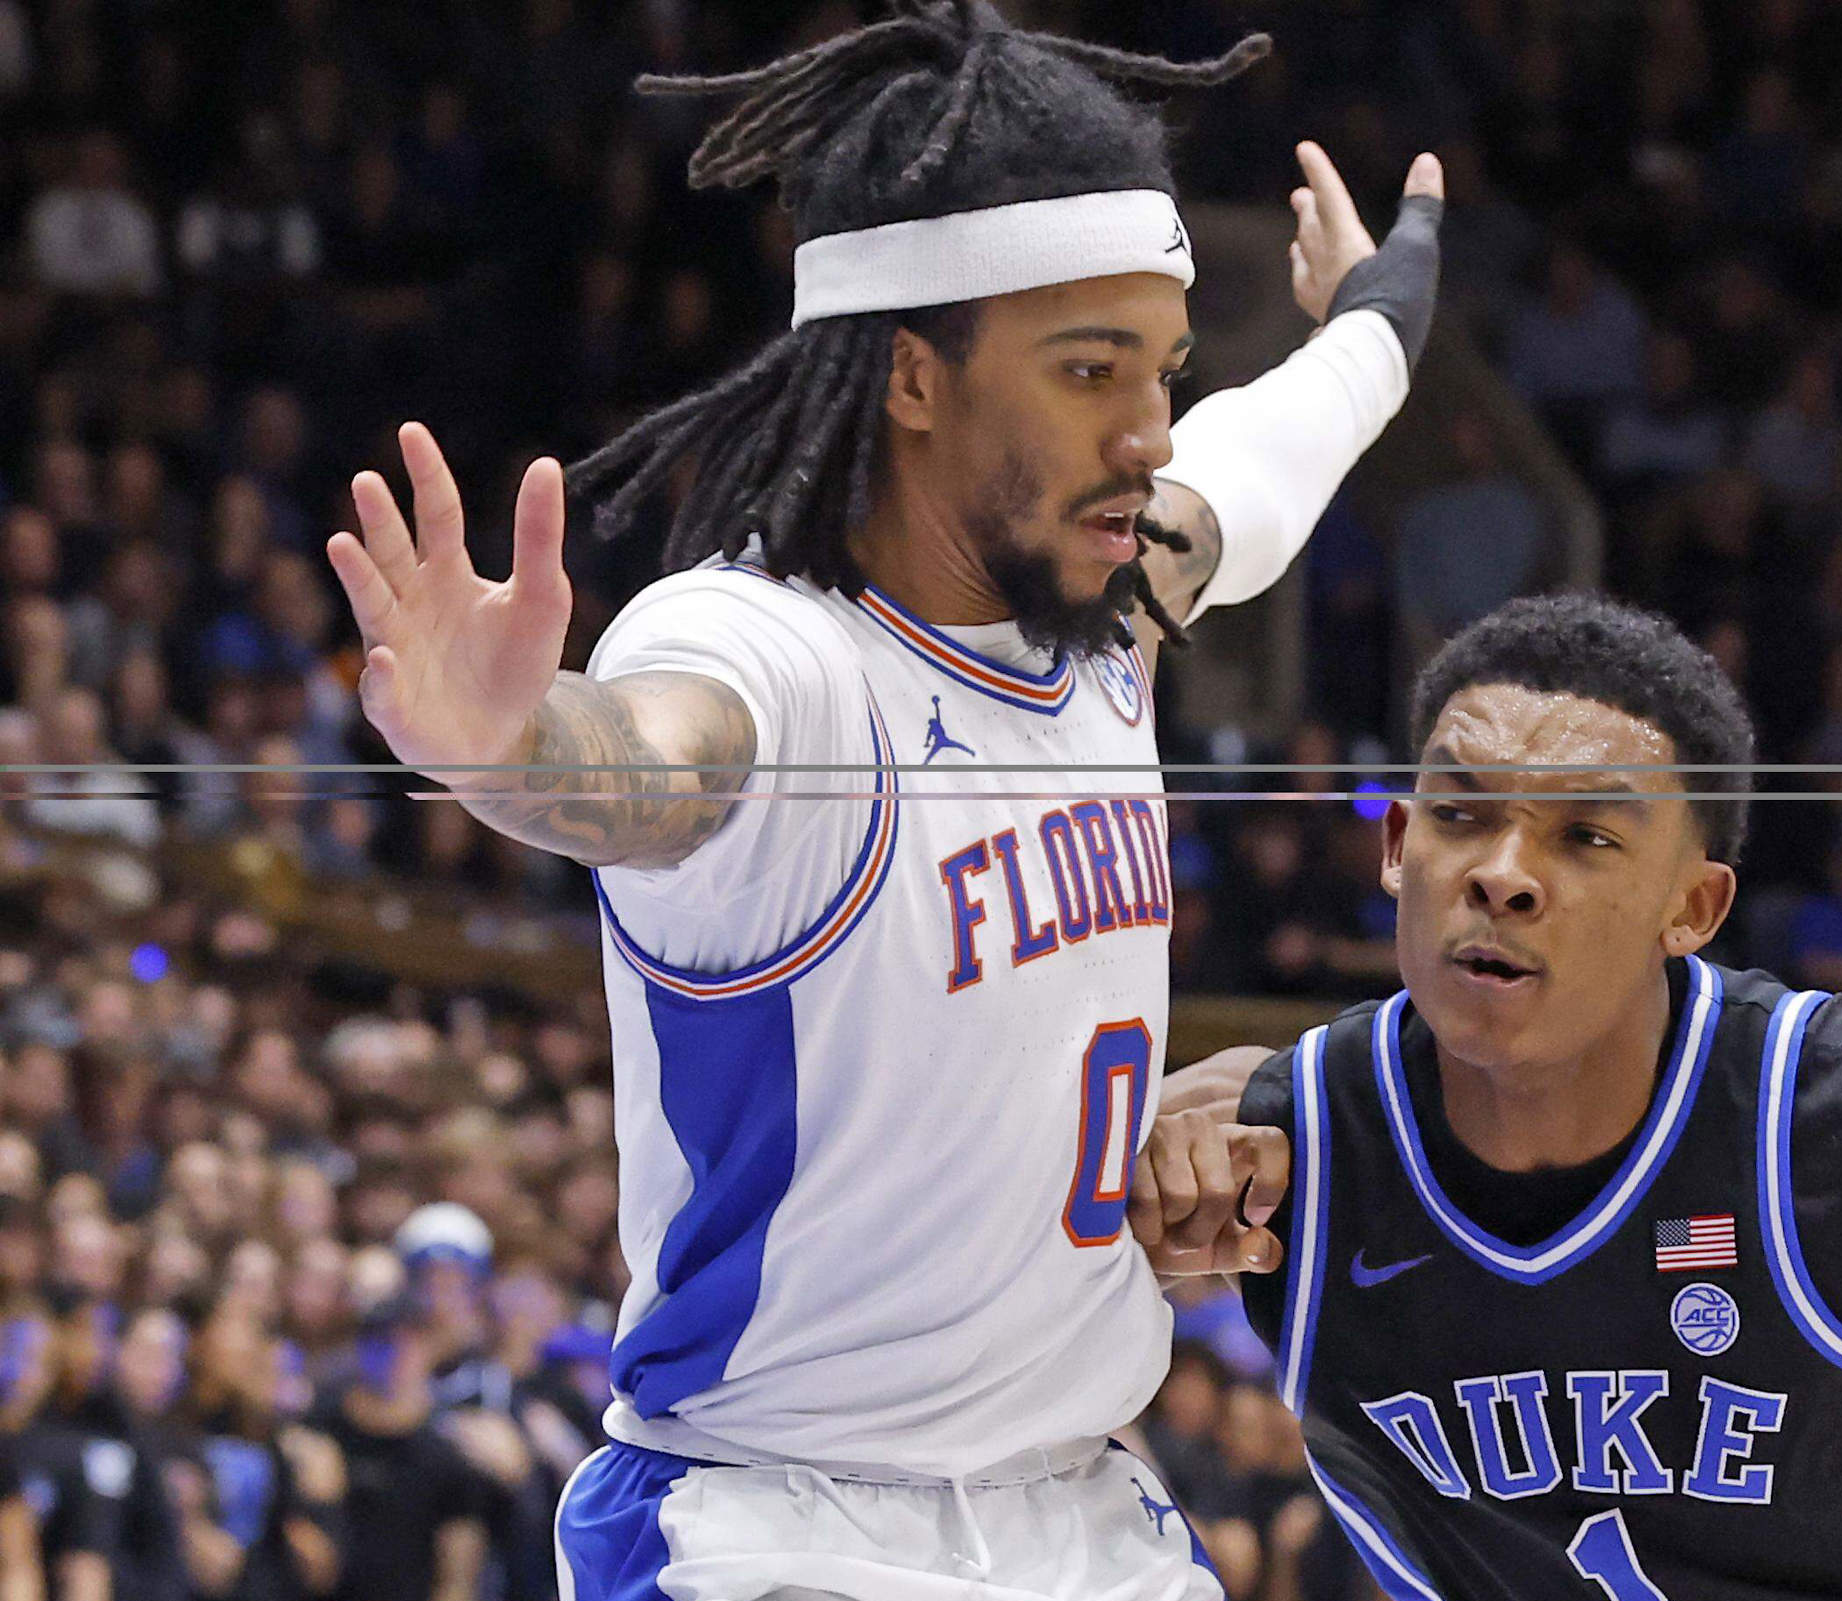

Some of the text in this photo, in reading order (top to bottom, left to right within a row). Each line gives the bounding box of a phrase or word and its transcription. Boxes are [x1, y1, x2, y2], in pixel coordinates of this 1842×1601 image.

[938, 799, 1170, 995] FLORID
[1062, 1016, 1153, 1248] 0
[1684, 1307, 1731, 1323] ACC
[1359, 1370, 1788, 1504] DUKE
